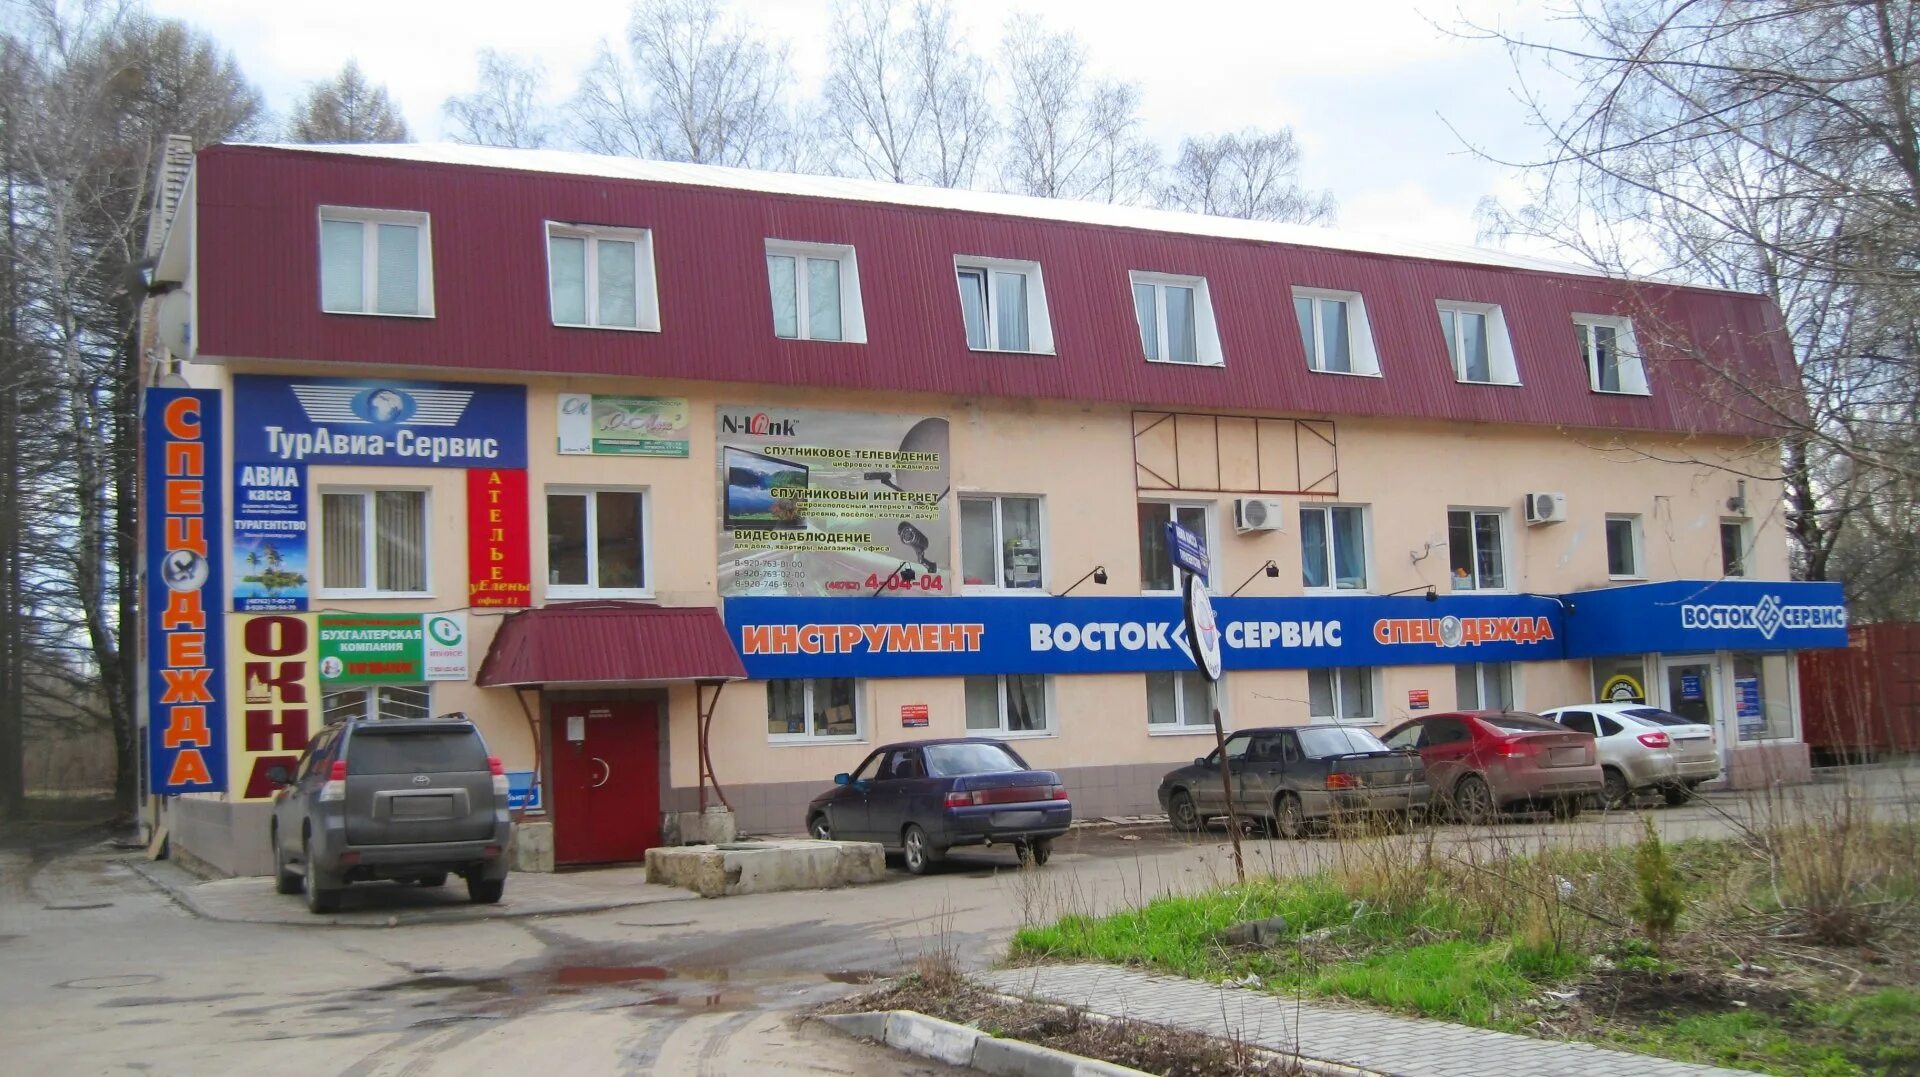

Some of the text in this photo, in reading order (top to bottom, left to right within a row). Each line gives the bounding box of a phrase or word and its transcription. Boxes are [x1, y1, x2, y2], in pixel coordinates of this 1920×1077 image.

[265, 426, 498, 462] ТурАвиа-Сервис
[764, 446, 940, 462] СПУТНИКОВОЕ ТЕЛЕВИДЕНИЕ
[832, 461, 872, 469] цифровое
[241, 466, 299, 487] АВИА
[248, 490, 292, 501] касса
[770, 488, 939, 502] СПУТНИКОВЫЙ ИНТЕРНЕТ
[234, 519, 307, 531] ТУРАГЕНТСТВО
[488, 471, 504, 580] АТЕЛЬЕ
[734, 530, 872, 543] ВИДЕОНАБЛЮДЕНИЕ
[1681, 604, 1846, 629] ВОСТОК СЕРВИС
[321, 629, 422, 641] БУХГАЛТЕРСКАЯ
[742, 622, 985, 655] ИНСТРУМЕНТ
[1029, 620, 1342, 652] ВОСТОК СЕРВИС
[340, 642, 404, 652] КОМПАНИЯ
[244, 615, 309, 799] ОКНА
